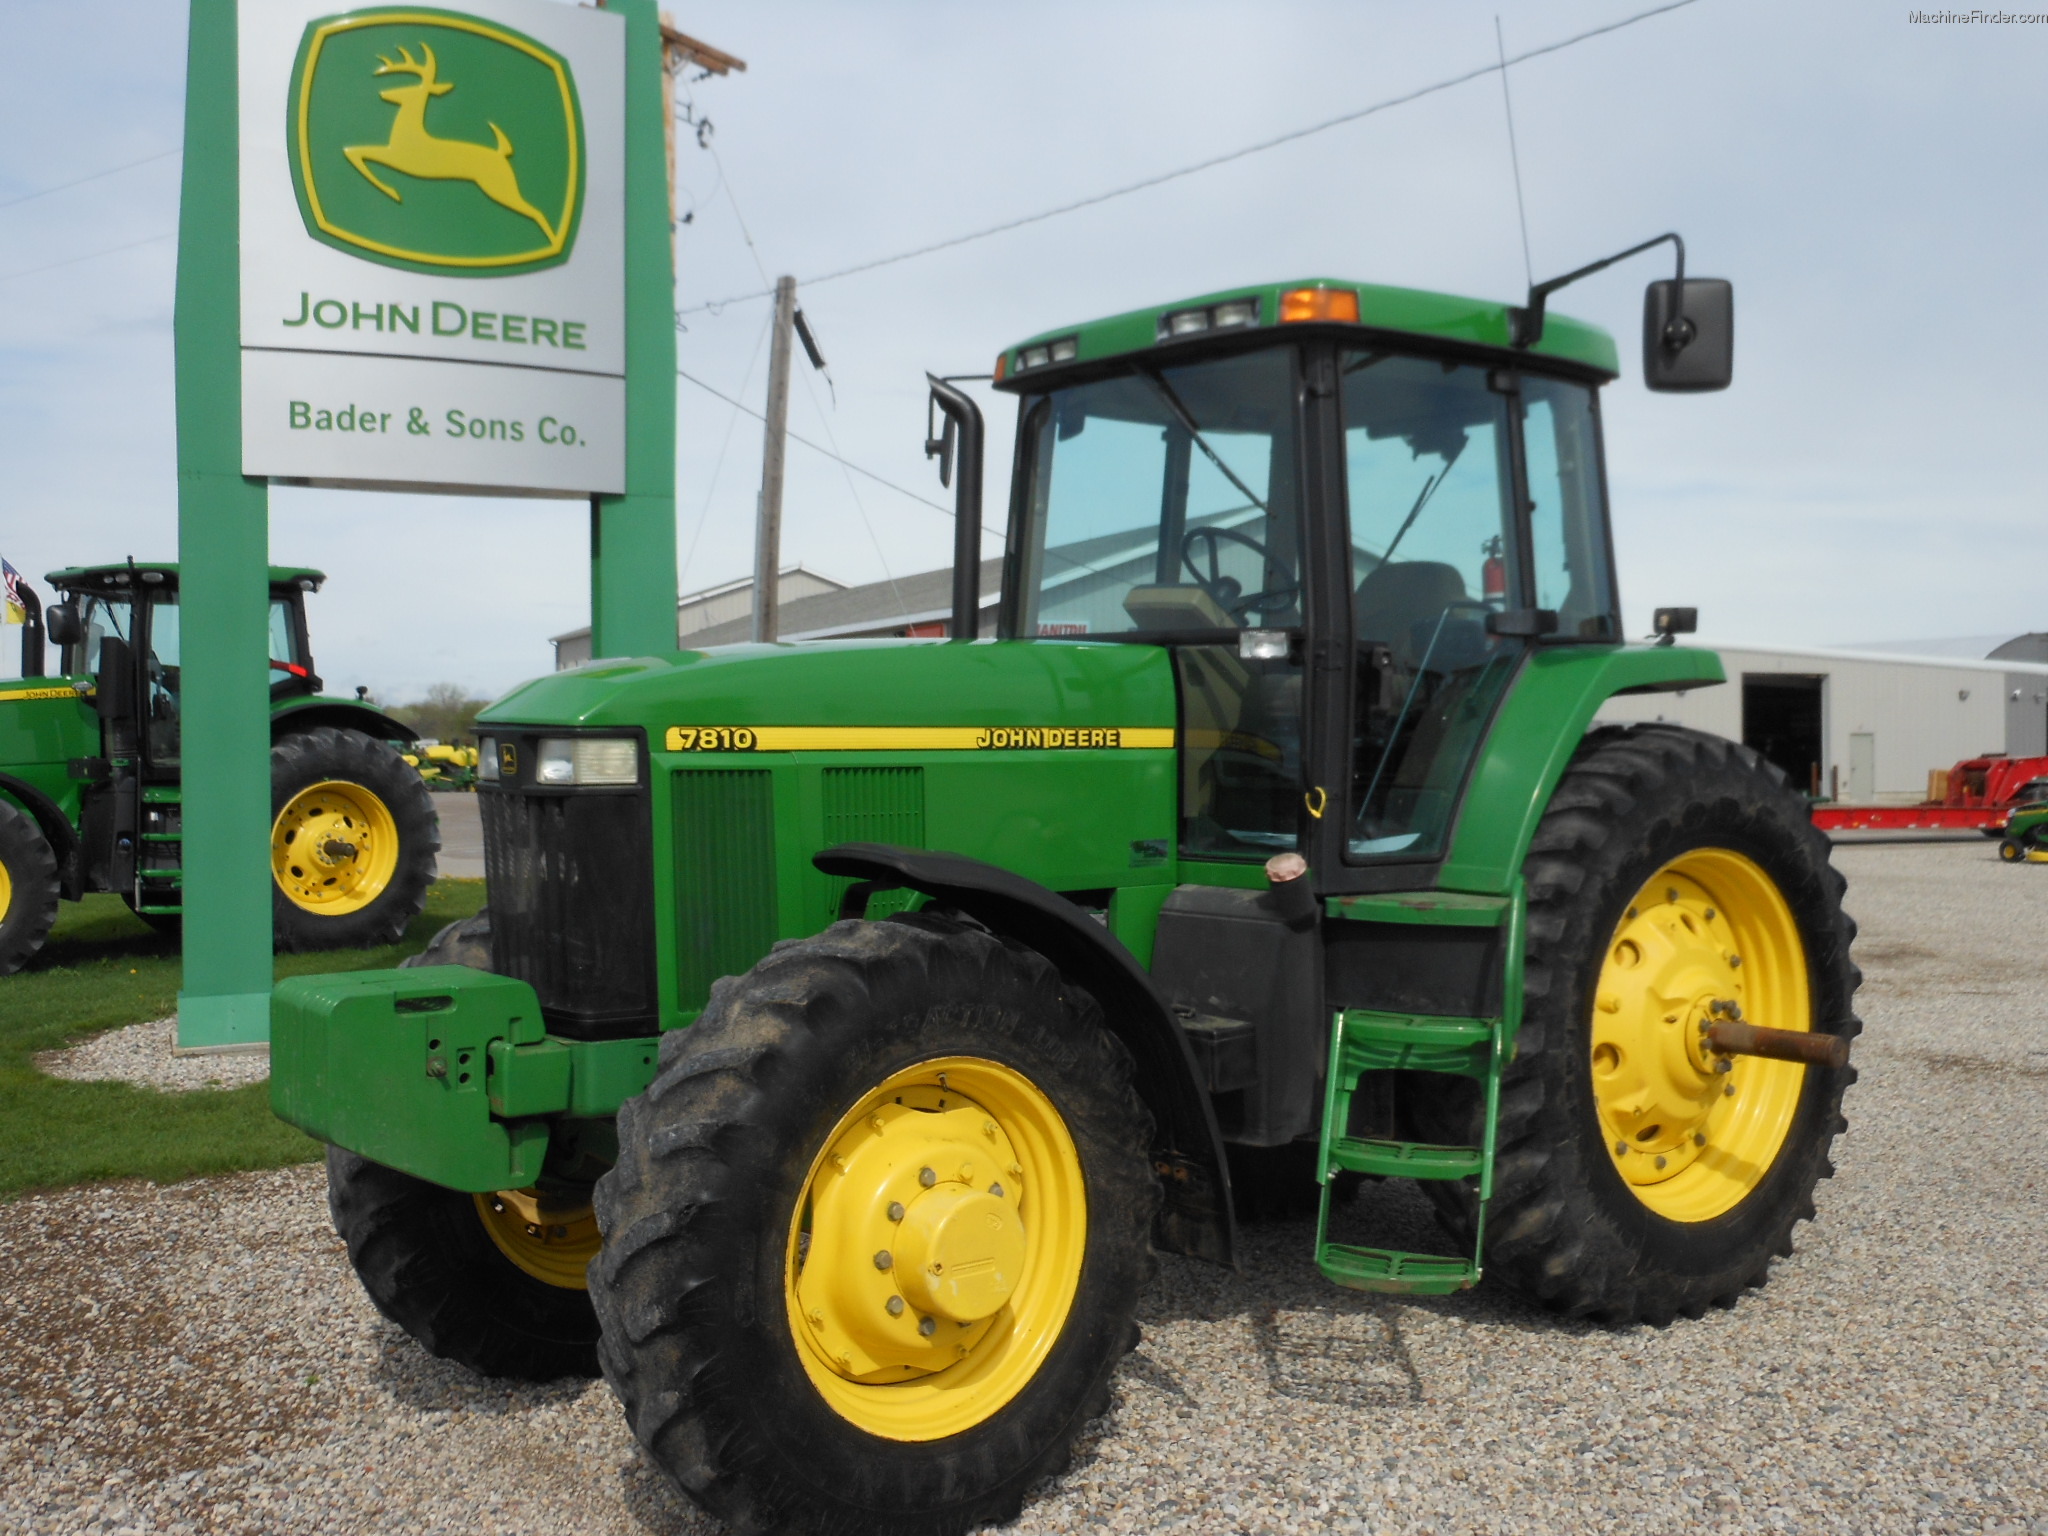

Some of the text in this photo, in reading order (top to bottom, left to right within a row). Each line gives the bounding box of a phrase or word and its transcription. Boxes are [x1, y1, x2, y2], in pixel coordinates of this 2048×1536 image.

[283, 291, 587, 350] JOHN DEERE
[289, 400, 586, 447] Bader & Sons Co.
[23, 690, 50, 699] JOHN
[679, 727, 758, 751] 7810
[976, 728, 1121, 749] JOHN DEERE
